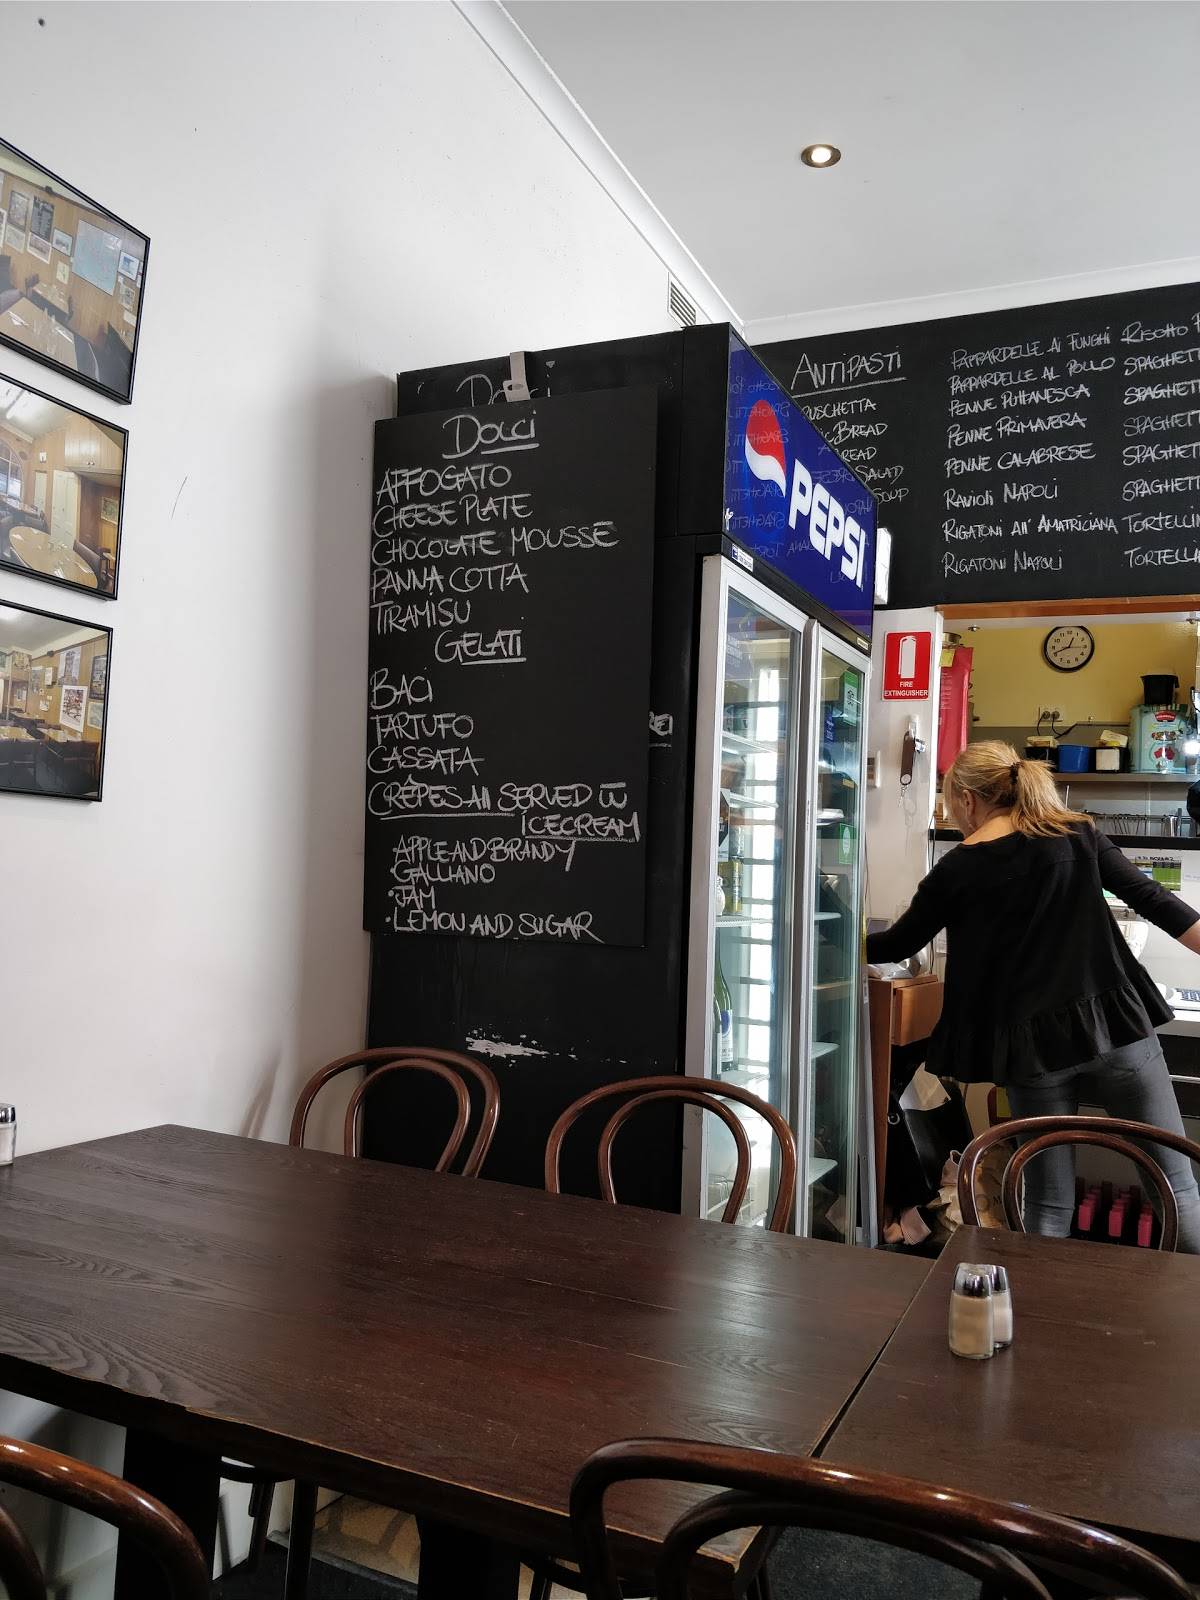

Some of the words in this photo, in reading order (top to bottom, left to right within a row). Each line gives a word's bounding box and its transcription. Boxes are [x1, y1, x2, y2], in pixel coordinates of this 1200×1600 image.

[1066, 327, 1111, 351] FUNGHI
[790, 346, 902, 390] ANTIPASTI
[1041, 366, 1060, 381] AL
[1066, 357, 1116, 377] POLLO
[801, 398, 877, 420] RUSCHETTA
[948, 397, 998, 417] PENNE
[1001, 383, 1091, 409] PUTTANESCA
[442, 409, 537, 459] DOLCI
[832, 420, 889, 445] BREAD
[946, 423, 993, 449] PENNE
[996, 412, 1088, 438] PRIMAVERA
[837, 446, 877, 462] READ
[944, 455, 993, 478] PENNE
[997, 443, 1096, 470] CALABRESE
[376, 464, 512, 505] AFFOGATO
[855, 465, 904, 485] SALAD
[1003, 478, 1058, 503] NAPOLI
[373, 501, 458, 537] CHEESE
[459, 493, 533, 525] PLATE
[788, 458, 866, 588] PEPSI
[942, 518, 1003, 542] RIGATONI
[1037, 512, 1119, 535] AMATRICIANA
[372, 530, 501, 566] CHOCOLATE
[511, 521, 621, 556] MOUSSE
[1124, 540, 1200, 568] TORTELLI
[941, 551, 1007, 578] RIGATONI
[1013, 549, 1062, 573] NAPOLI
[370, 565, 444, 602] PANNA
[450, 563, 530, 593] COTTA
[370, 598, 470, 635] TIRAMISU
[435, 622, 523, 663] GELATI
[370, 668, 433, 709] BACI
[884, 689, 929, 697] EXTINGUISHER
[899, 680, 914, 688] FIRE
[370, 711, 474, 745] TARTUFO
[367, 746, 485, 776] CASSATA
[498, 782, 593, 812] SERVED
[521, 810, 641, 842] ICECREAM
[393, 835, 450, 863] APPLE
[449, 837, 487, 863] AND
[487, 837, 577, 871] BRANDY
[393, 860, 496, 885] GALLIANO
[393, 885, 436, 909] JAM
[392, 907, 465, 932] LEMON
[469, 913, 514, 938] AND
[518, 911, 606, 944] SUGAR
